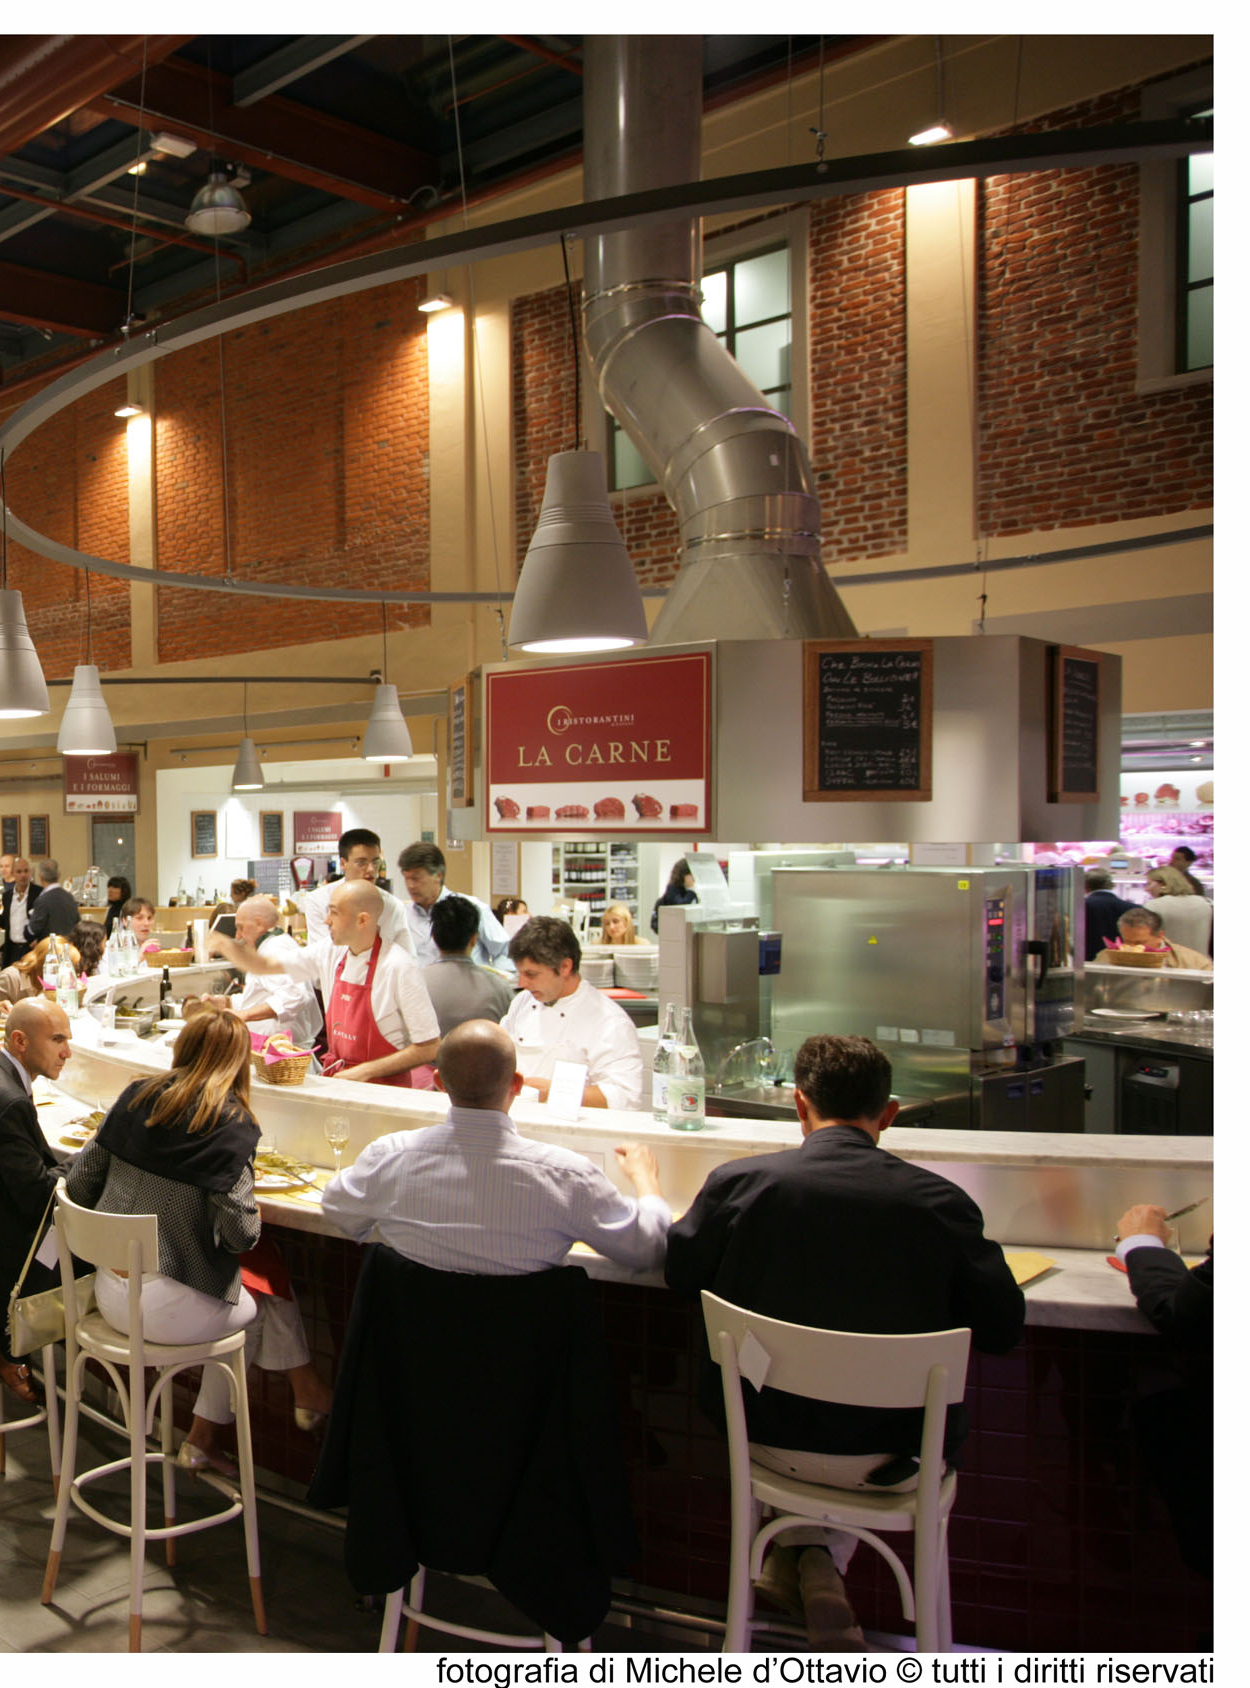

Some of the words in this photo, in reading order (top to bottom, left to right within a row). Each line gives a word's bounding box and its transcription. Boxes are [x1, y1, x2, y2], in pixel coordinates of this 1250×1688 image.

[563, 714, 635, 726] RISTORANTINI
[518, 746, 553, 767] LA
[565, 740, 672, 766] CARNE
[87, 783, 131, 792] FORMAGGI
